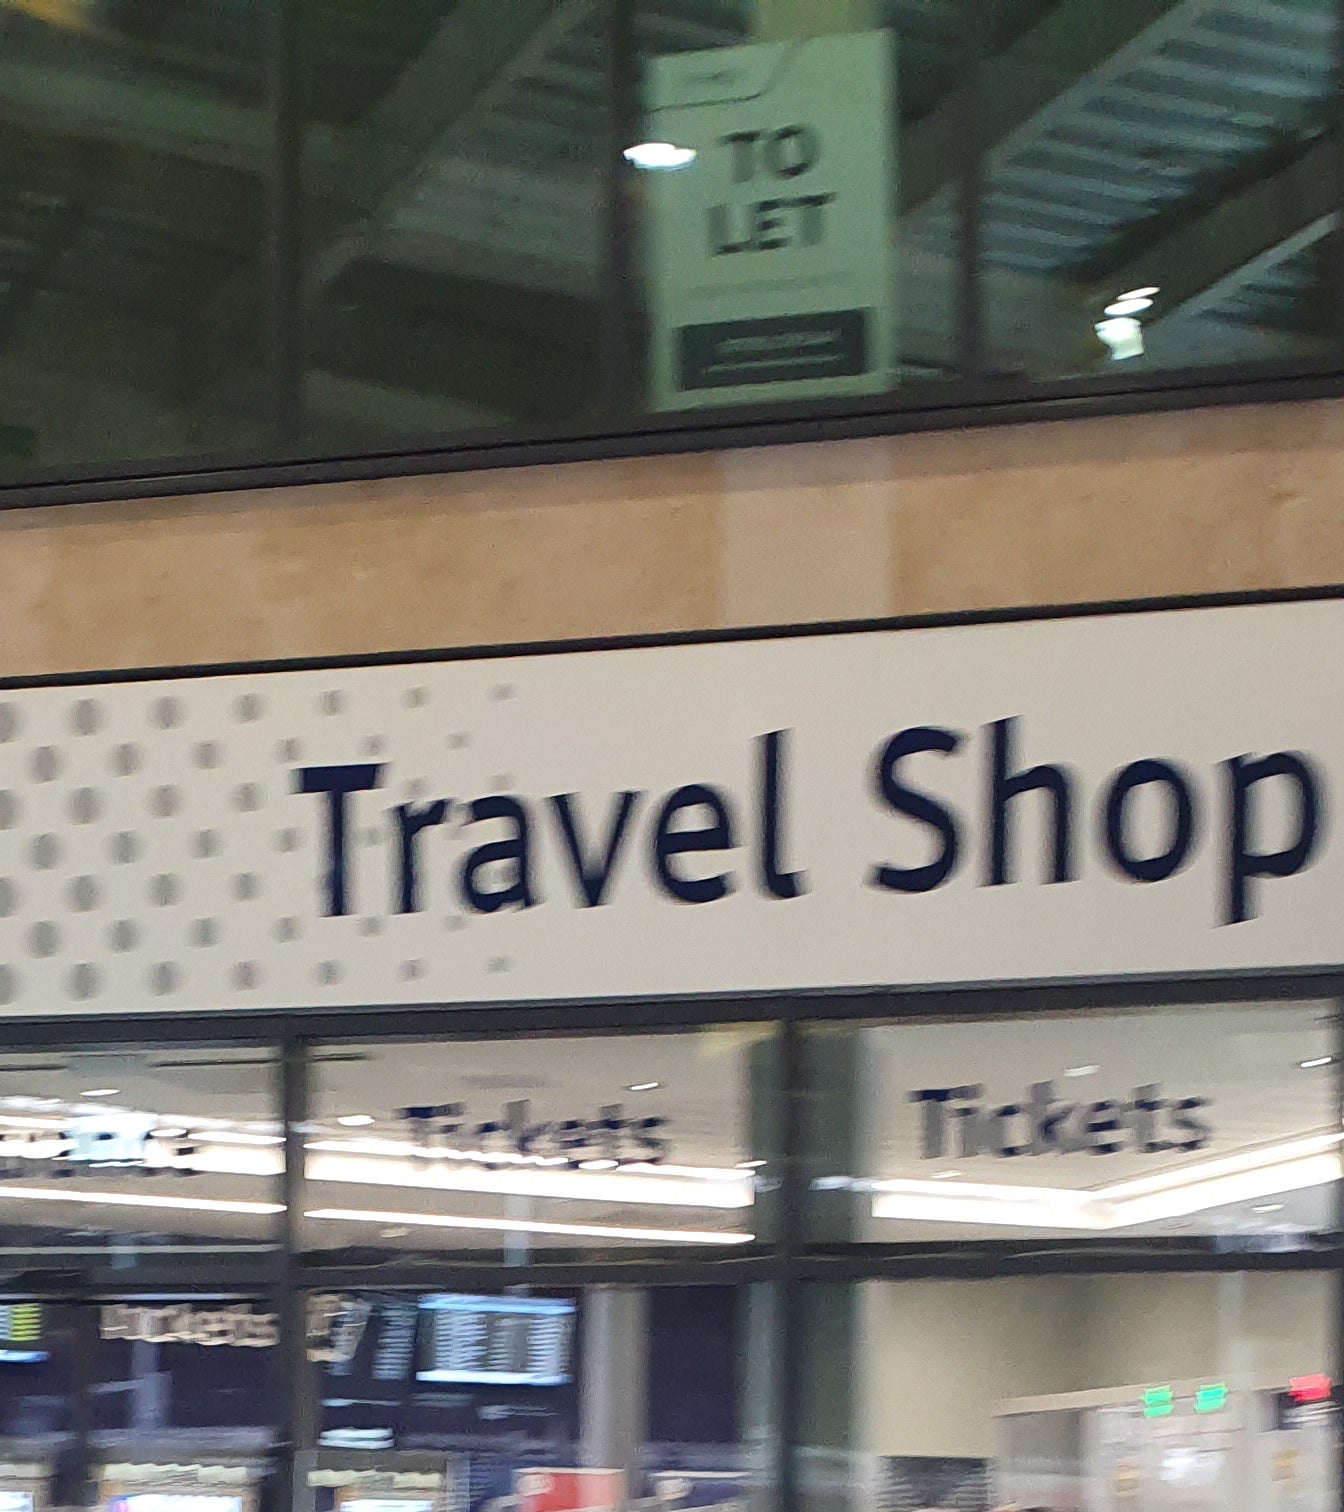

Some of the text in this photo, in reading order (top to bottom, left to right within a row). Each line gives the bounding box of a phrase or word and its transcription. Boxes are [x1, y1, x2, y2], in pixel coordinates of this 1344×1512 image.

[720, 123, 823, 184] TO
[707, 191, 838, 257] LET
[290, 713, 1330, 930] Travel Shop
[908, 1078, 1213, 1160] Tickets
